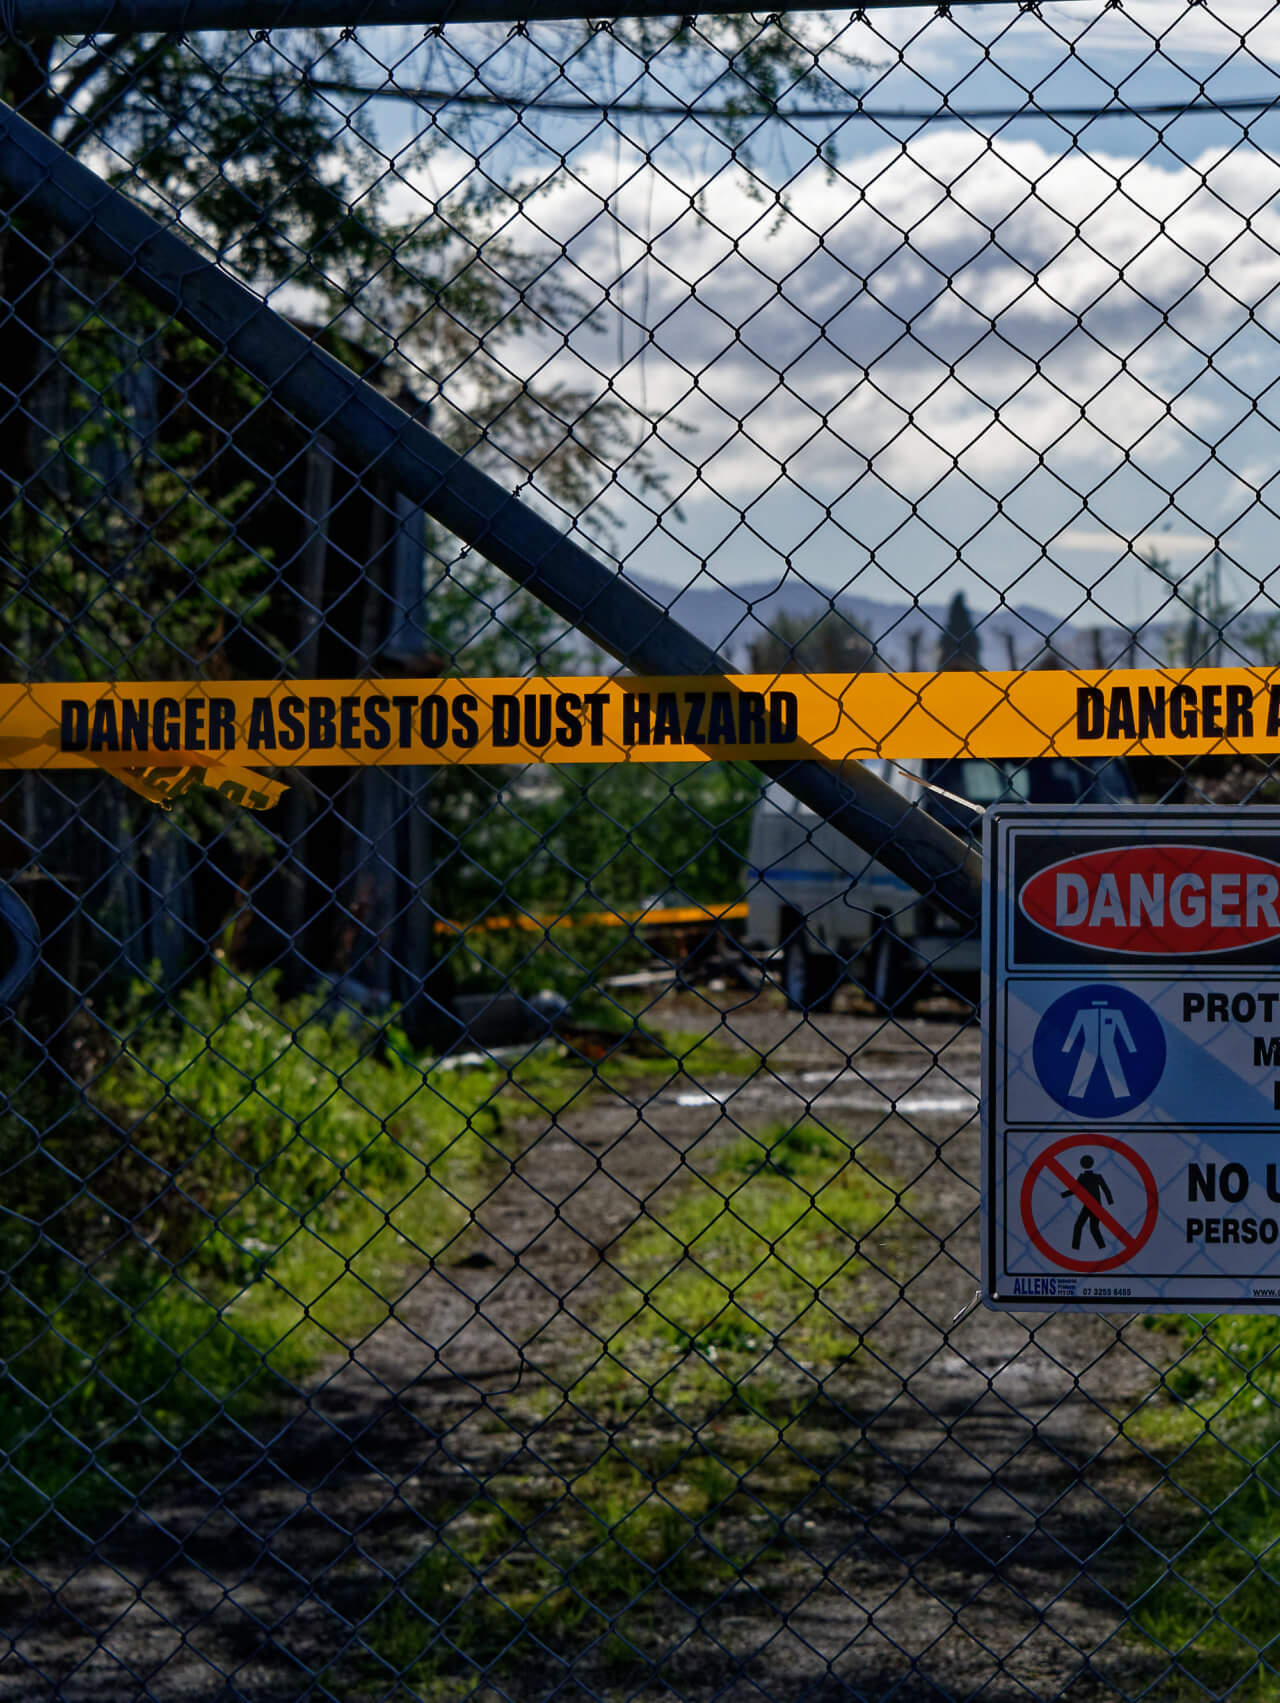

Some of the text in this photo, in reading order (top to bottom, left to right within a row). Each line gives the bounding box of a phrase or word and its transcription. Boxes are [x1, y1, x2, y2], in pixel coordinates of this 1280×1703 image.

[60, 690, 798, 753] DANGER ASBESTOS DUST HAZARD
[1076, 682, 1254, 740] DANGER
[1055, 872, 1280, 929] DANGER
[1188, 1162, 1249, 1203] NO
[1014, 1278, 1057, 1295] ALLENS
